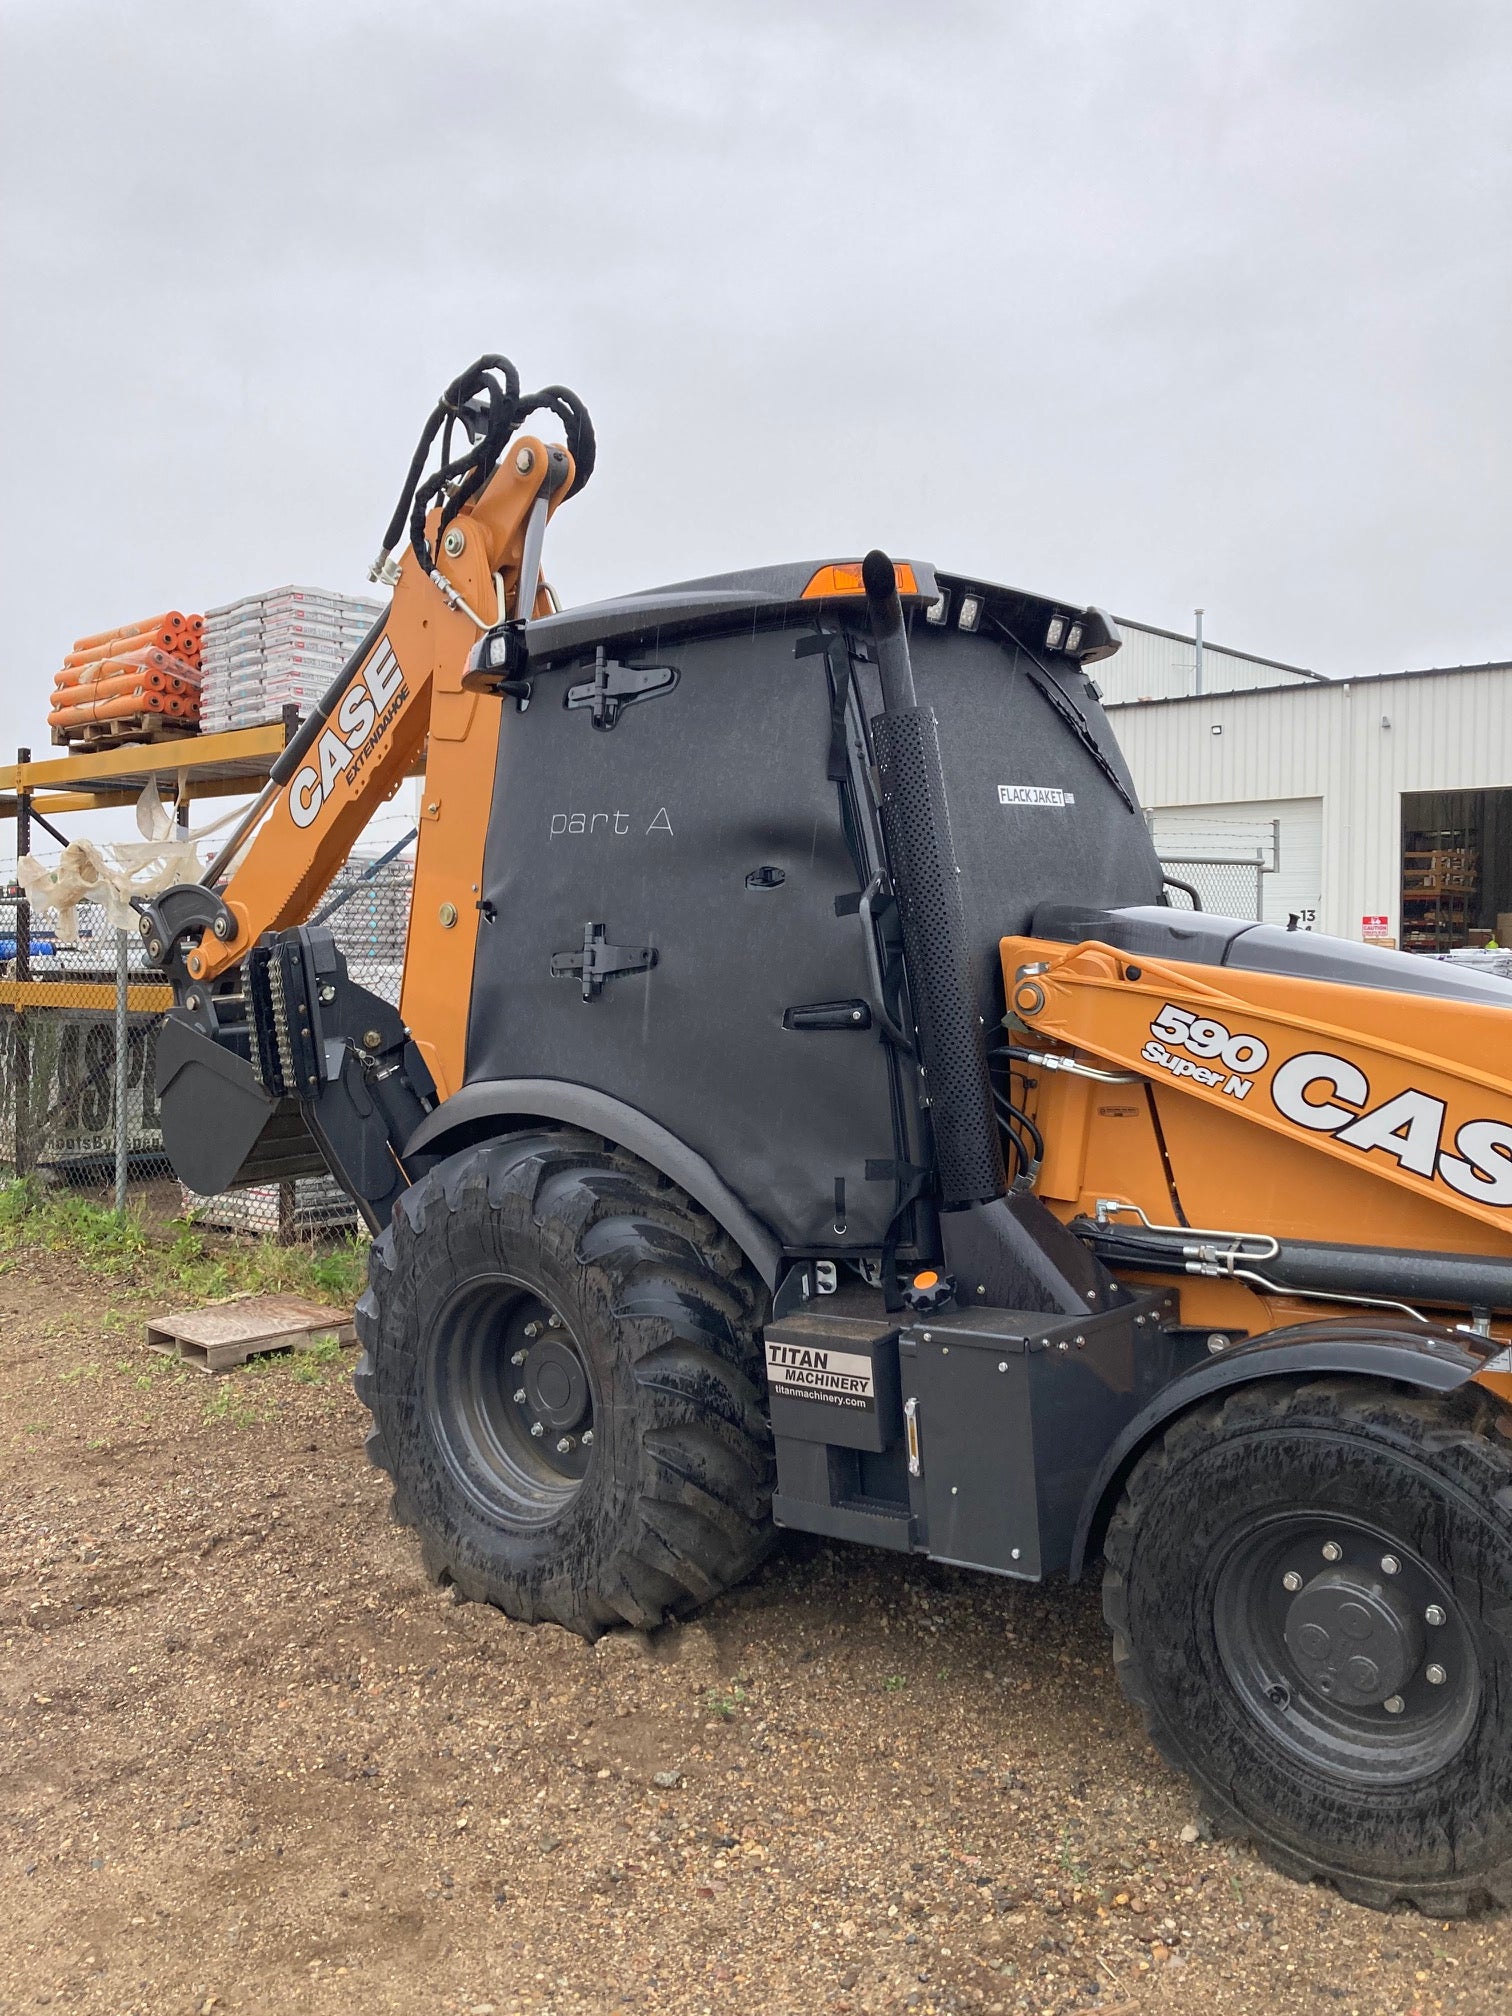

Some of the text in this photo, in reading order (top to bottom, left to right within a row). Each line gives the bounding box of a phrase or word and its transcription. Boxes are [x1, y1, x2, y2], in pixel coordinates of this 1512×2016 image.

[289, 634, 404, 829] CASE
[345, 682, 411, 786] EXTENDAHOE
[549, 806, 674, 841] part A
[1300, 909, 1316, 922] 13
[1149, 1002, 1269, 1075] 590
[1140, 1040, 1255, 1101] Super N
[769, 1345, 828, 1370] TITAN
[775, 1384, 866, 1408] titanmachinery.com
[785, 1369, 868, 1393] MACHINERY
